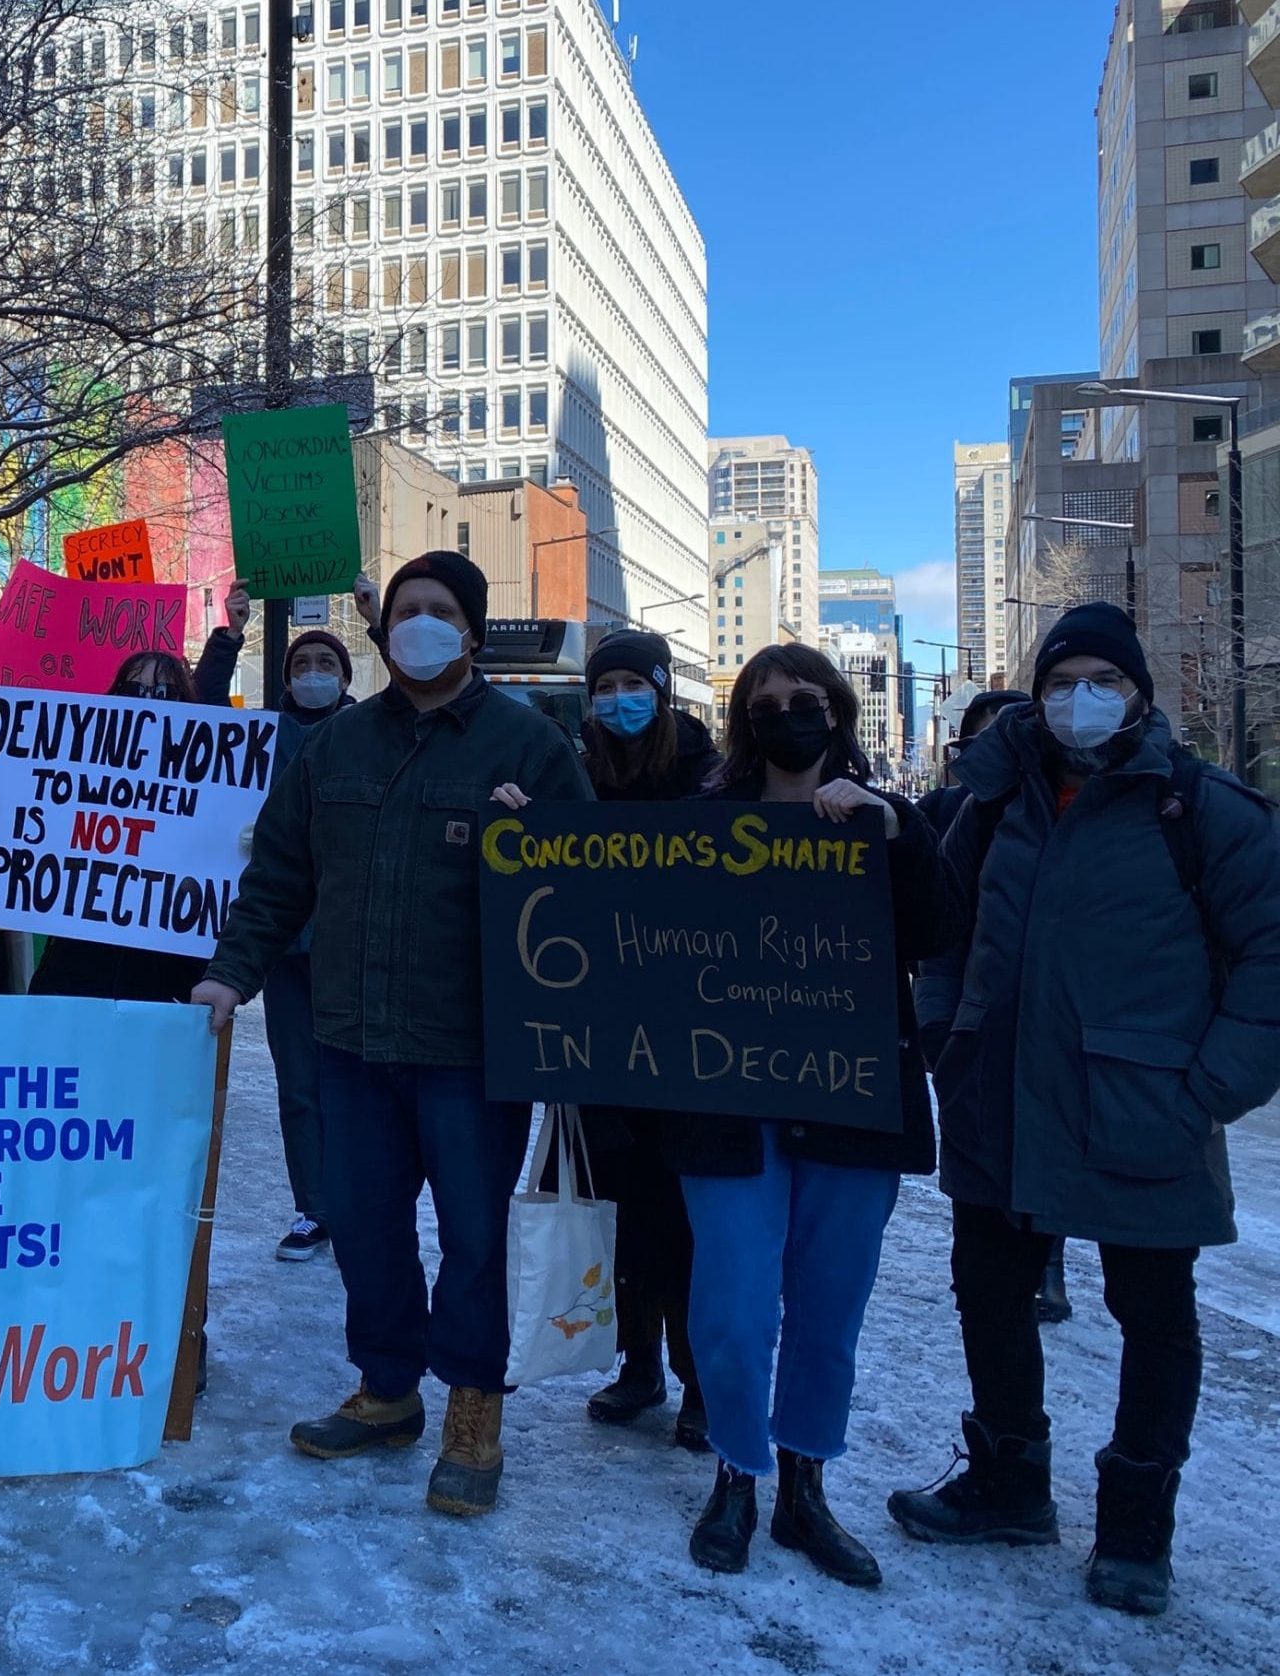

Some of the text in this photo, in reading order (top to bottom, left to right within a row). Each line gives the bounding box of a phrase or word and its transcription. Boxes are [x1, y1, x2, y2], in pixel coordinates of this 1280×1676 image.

[65, 525, 143, 563] SECRECY
[251, 558, 348, 589] #IWWD22
[78, 597, 185, 650] WORK
[486, 624, 539, 632] ARRIER
[39, 653, 76, 679] OR
[158, 715, 276, 791] WORK
[32, 768, 199, 817] TO WOMEN
[13, 806, 156, 857] IS NOT
[516, 885, 873, 989] 6 Human Rights
[697, 965, 856, 1015] Complaints
[524, 1021, 881, 1097] IN A DECADE
